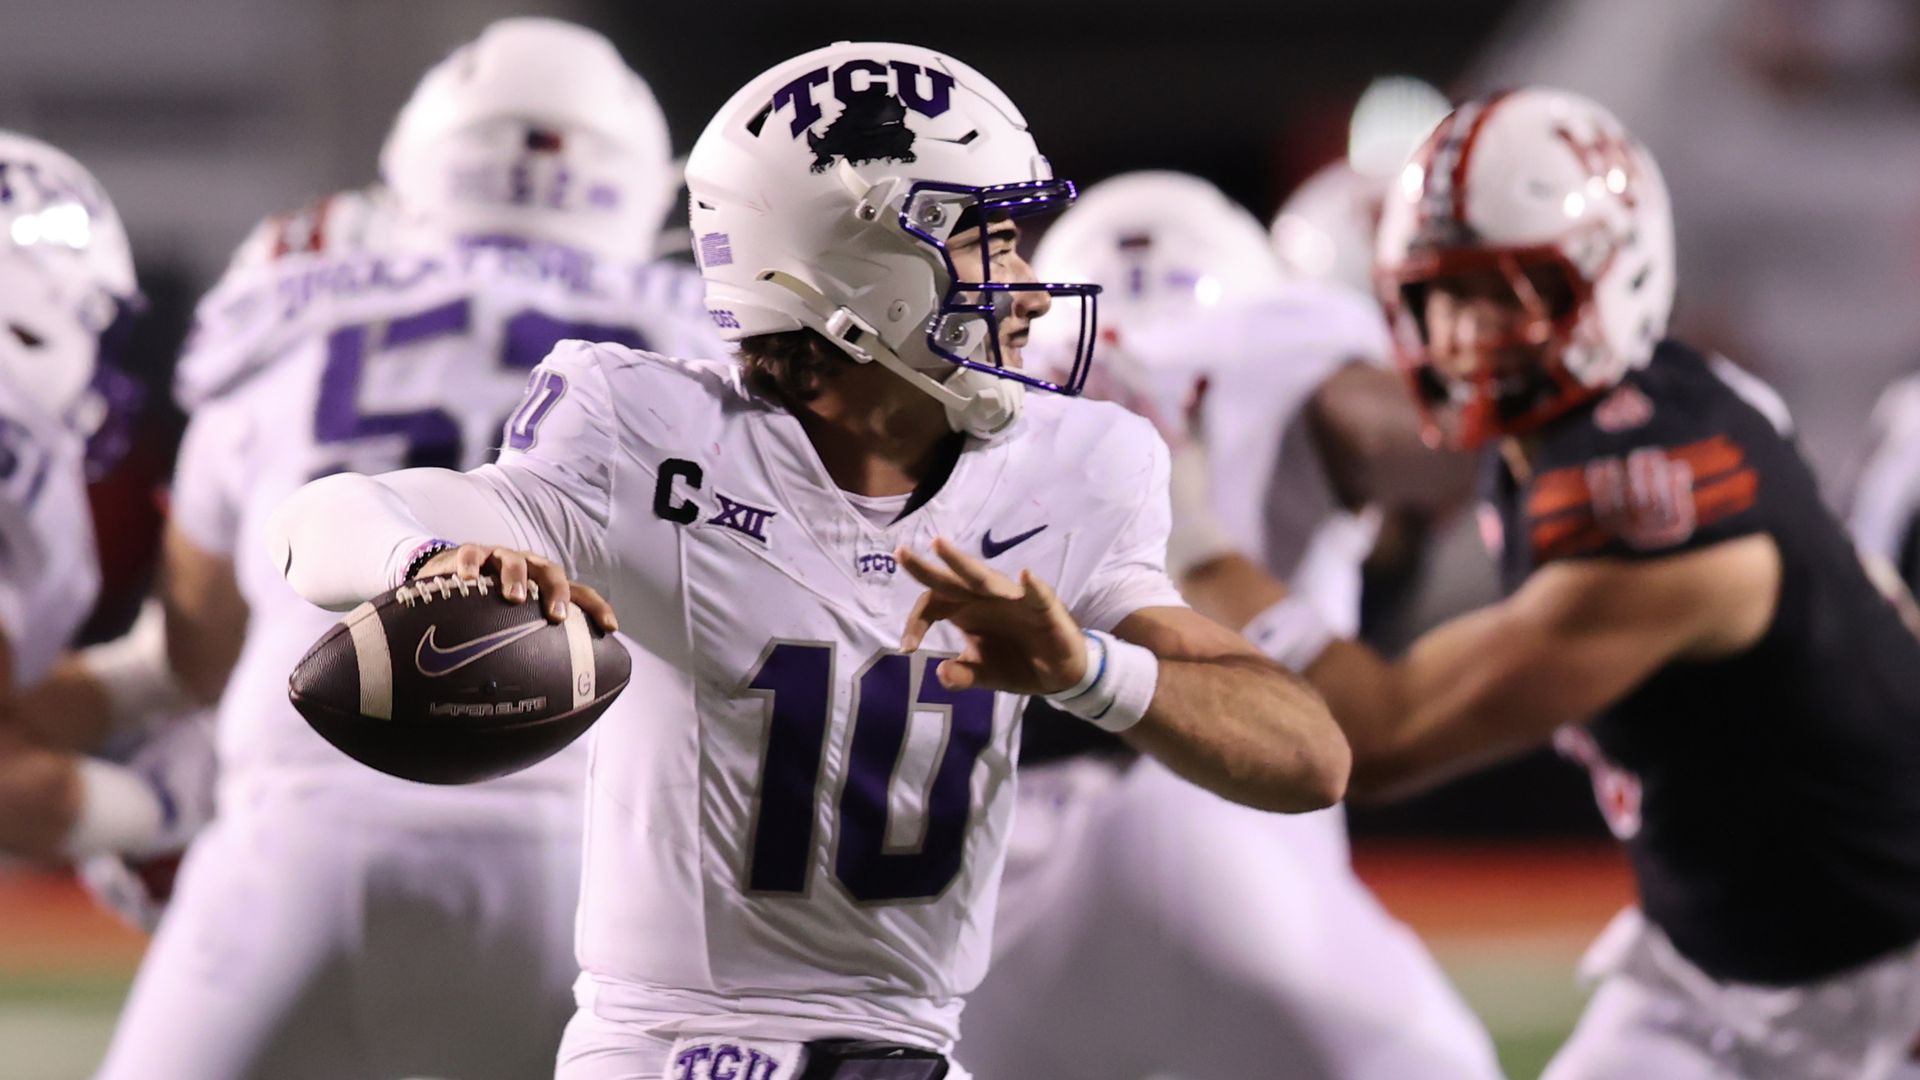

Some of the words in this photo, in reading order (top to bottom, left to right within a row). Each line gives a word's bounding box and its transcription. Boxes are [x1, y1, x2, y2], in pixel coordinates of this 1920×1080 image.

[773, 59, 955, 140] TCU
[653, 457, 703, 525] C
[706, 492, 777, 543] XII
[859, 553, 896, 575] TCU
[577, 671, 591, 696] G
[728, 637, 998, 907] 10
[678, 1044, 779, 1080] TCU
